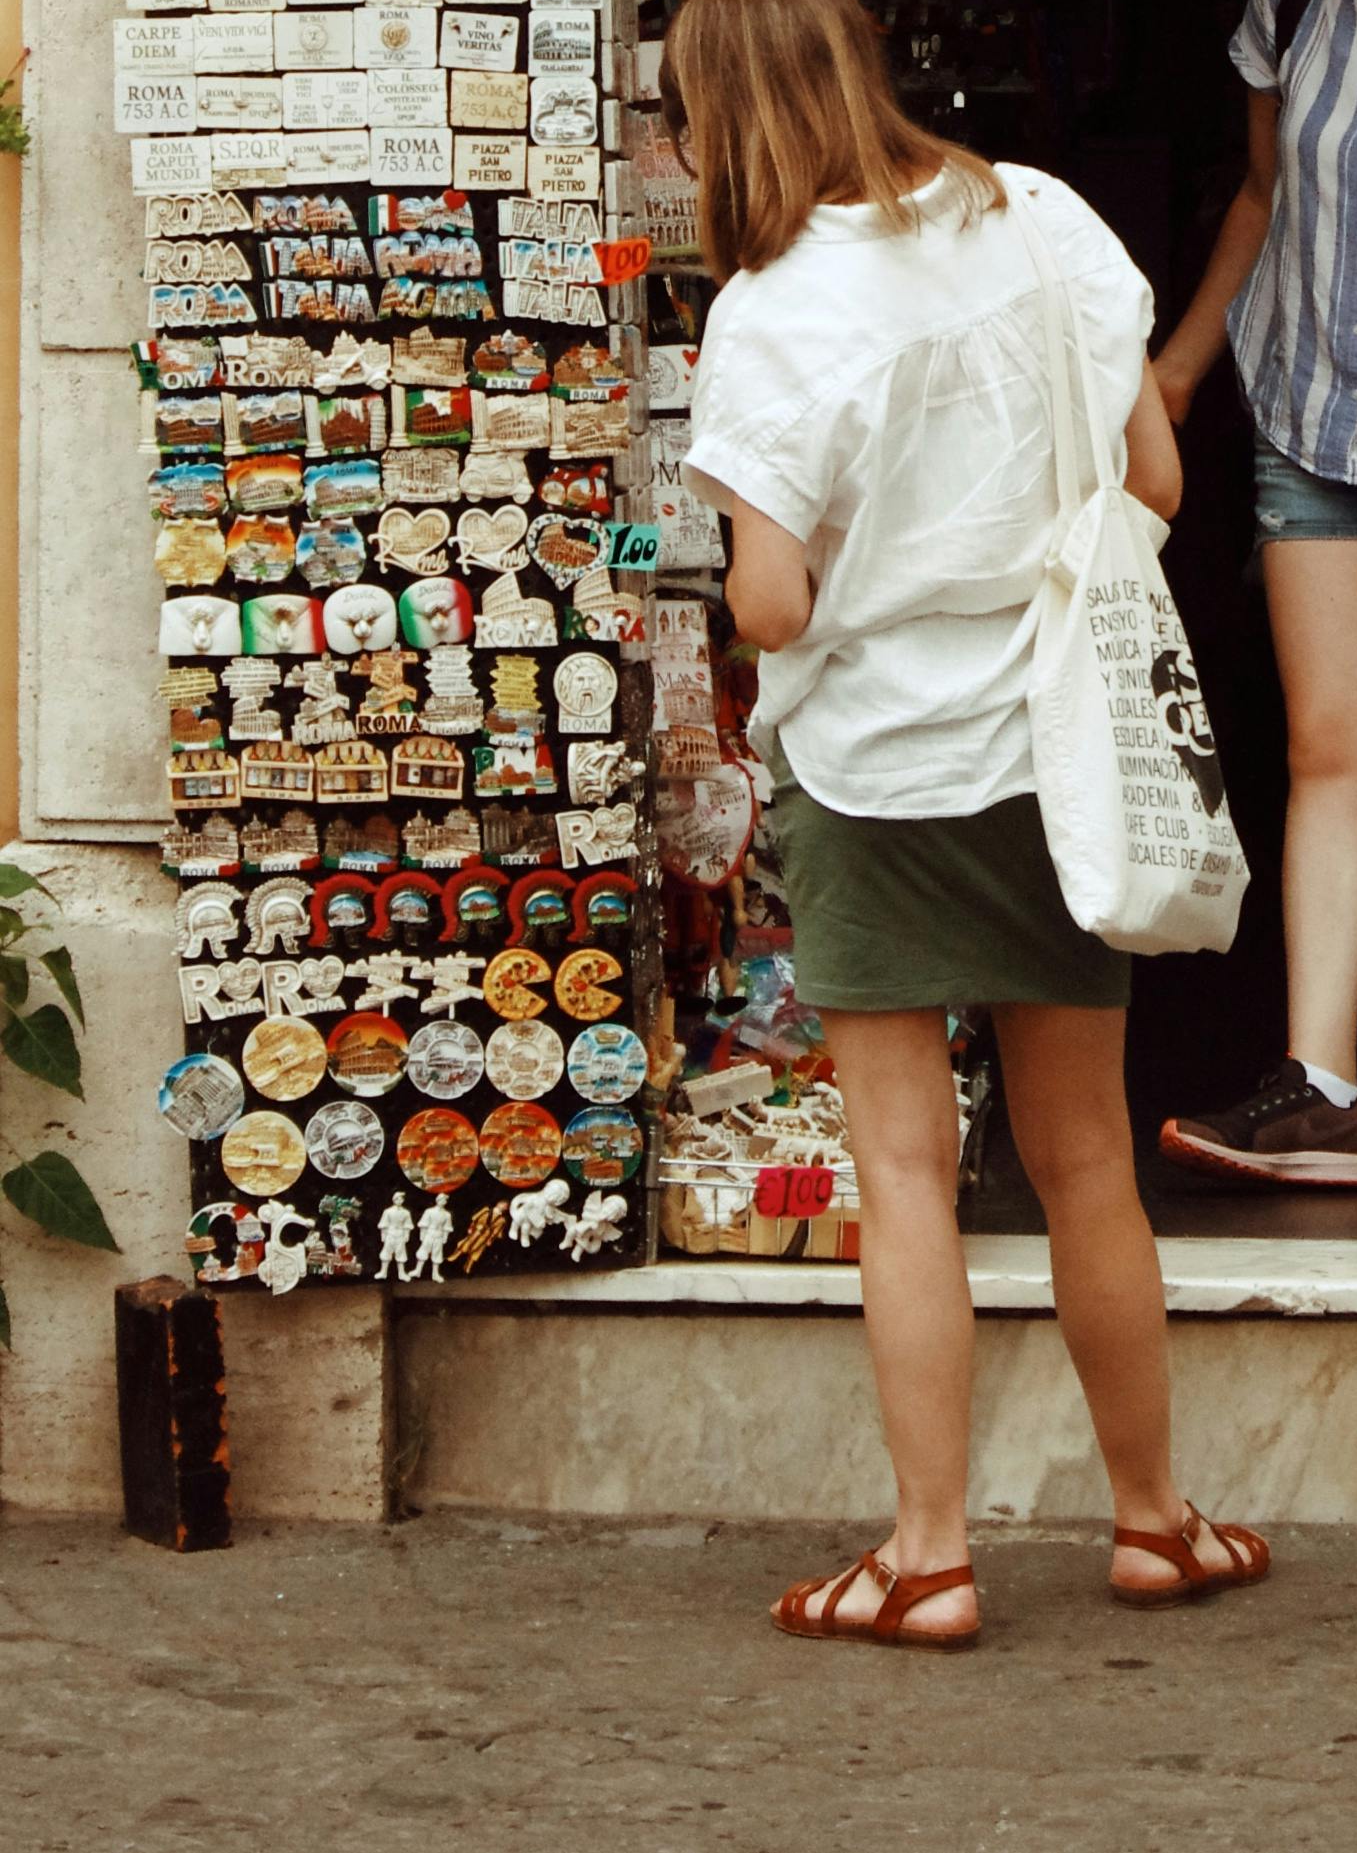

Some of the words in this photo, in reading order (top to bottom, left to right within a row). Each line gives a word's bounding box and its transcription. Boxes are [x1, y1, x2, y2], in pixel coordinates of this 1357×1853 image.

[299, 15, 327, 23] ROMA
[379, 11, 410, 20] ROMA
[475, 19, 488, 30] IN
[556, 21, 591, 32] ROMA
[126, 26, 182, 41] CARPE
[467, 29, 495, 41] VINO
[131, 44, 176, 59] DIEM
[457, 39, 502, 52] VERITAS
[401, 72, 413, 83] IL
[128, 85, 185, 101] ROMA
[205, 89, 235, 99] ROMA
[376, 83, 439, 93] COLOSSEO
[466, 82, 515, 97] ROMA
[123, 103, 154, 120] 753
[461, 103, 488, 117] 753
[149, 142, 194, 154] ROMA
[219, 138, 281, 161] S.P.Q.R
[293, 145, 322, 154] ROMA
[383, 138, 440, 154] ROMA
[472, 143, 511, 155] PIAZZA
[146, 155, 198, 168] CAPUT
[378, 155, 409, 172] 753
[480, 156, 500, 166] SAN
[545, 154, 584, 165] PIAZZA
[145, 168, 201, 182] MUNDI
[468, 169, 512, 182] PIETRO
[553, 167, 574, 177] SAN
[541, 179, 586, 192] PIETRO
[145, 191, 253, 238] ROMA
[498, 197, 601, 244] ITALIA
[144, 240, 252, 284] ROMA
[499, 238, 604, 283] ITALIA
[148, 282, 257, 328] ROMA
[503, 279, 608, 327] ITALIA
[225, 359, 313, 388] ROMA
[491, 377, 530, 390] ROMA
[573, 389, 608, 400] ROMA
[1123, 579, 1142, 603] DE
[474, 614, 559, 648] ROMA
[563, 606, 646, 643] ROMA
[1101, 671, 1111, 689] Y
[356, 715, 423, 734] ROMA
[561, 717, 610, 731] ROMA
[259, 792, 295, 800] ROMA
[337, 794, 372, 802] ROMA
[410, 789, 445, 797] ROMA
[187, 800, 223, 808] ROMA
[1155, 815, 1190, 840] CLUB
[501, 855, 540, 866] ROMA
[1128, 841, 1177, 867] LOCALES
[1181, 848, 1199, 870] DE
[263, 862, 300, 873] ROMA
[342, 861, 376, 873] ROMA
[425, 859, 460, 869] ROMA
[180, 867, 218, 877] ROMA
